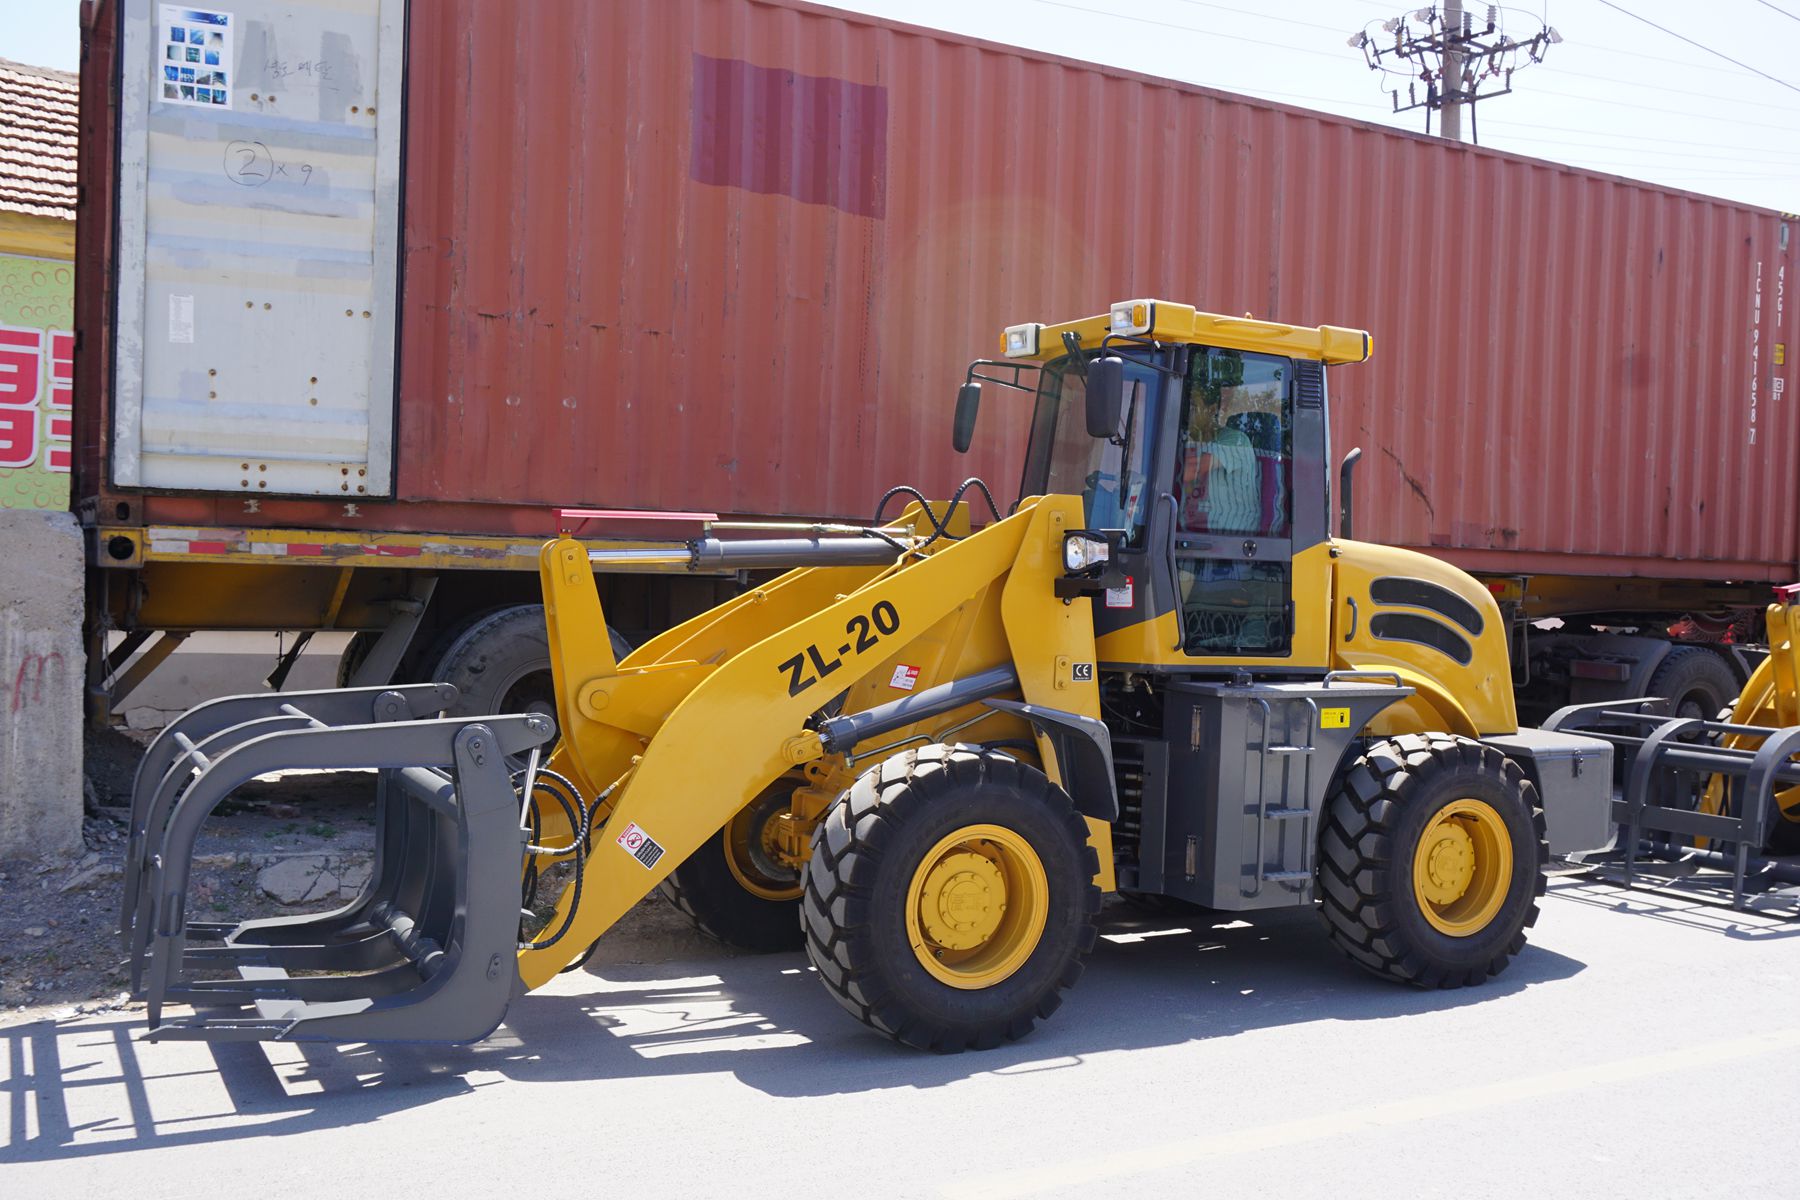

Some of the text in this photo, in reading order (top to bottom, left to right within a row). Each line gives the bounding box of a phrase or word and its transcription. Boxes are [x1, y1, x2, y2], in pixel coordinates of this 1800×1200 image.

[1777, 266, 1785, 328] 45G1
[1749, 262, 1762, 445] TCNU 941658 7
[778, 600, 900, 698] ZL-20
[1076, 665, 1089, 677] CE
